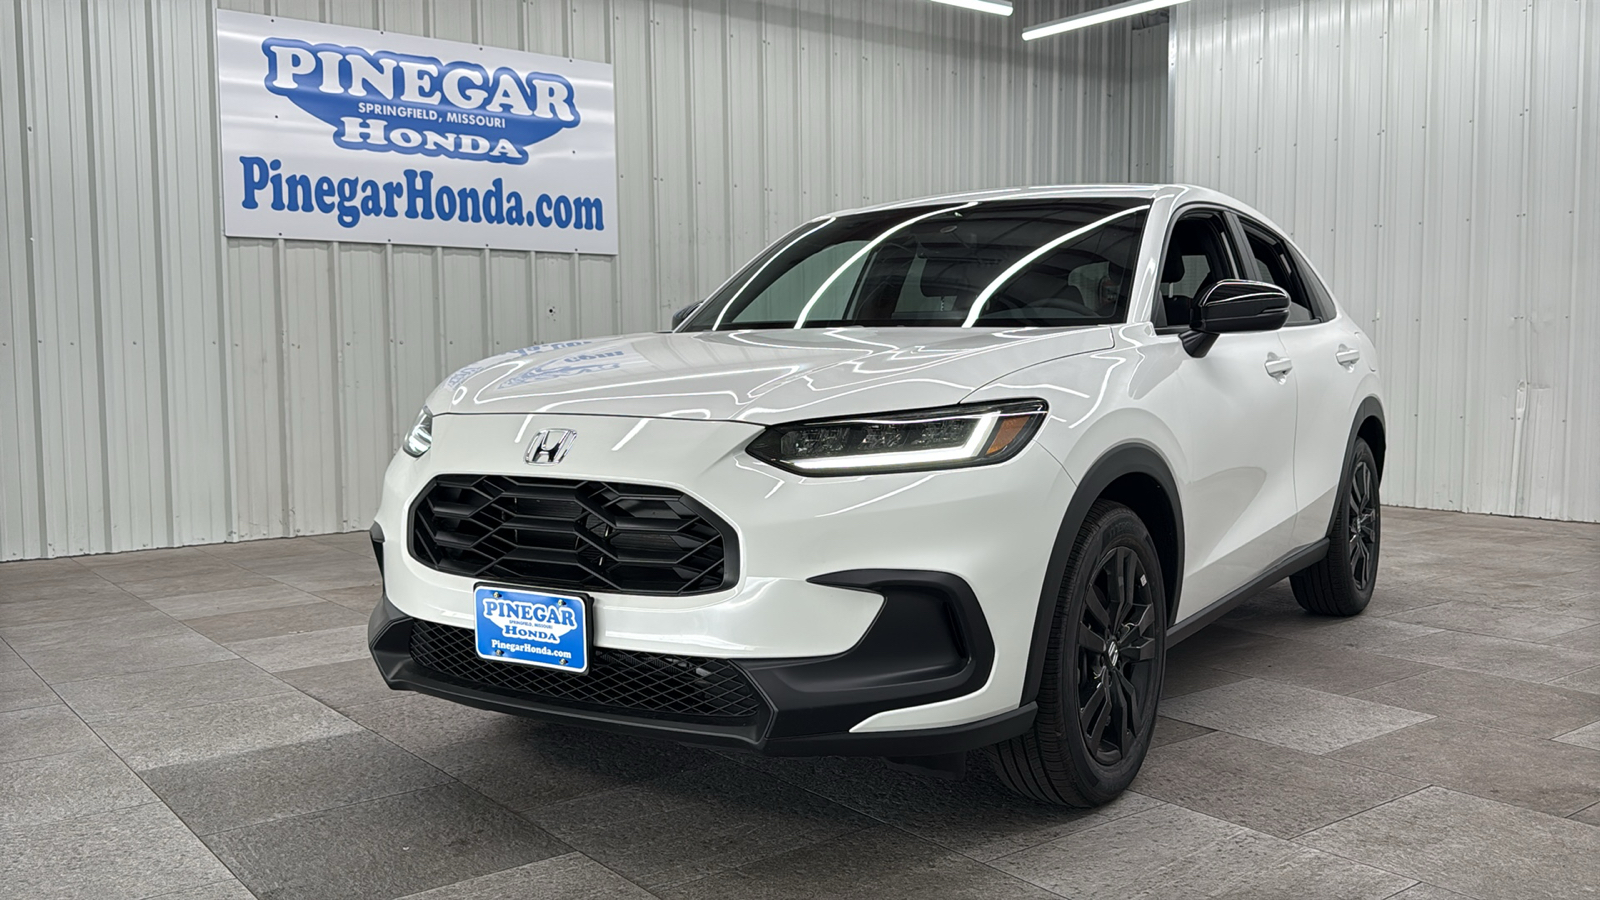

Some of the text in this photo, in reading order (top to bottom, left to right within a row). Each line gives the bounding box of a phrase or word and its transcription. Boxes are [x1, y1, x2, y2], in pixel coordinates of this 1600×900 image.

[270, 45, 575, 122] PINEGAR
[358, 102, 506, 128] SPRINGFIELD, MISSOURI
[340, 116, 523, 159] HONDA
[239, 155, 605, 231] PinegarHonda.com
[485, 601, 575, 626] PINEGAR
[504, 625, 558, 641] HONDA
[491, 639, 572, 659] PinegarHonda.com
